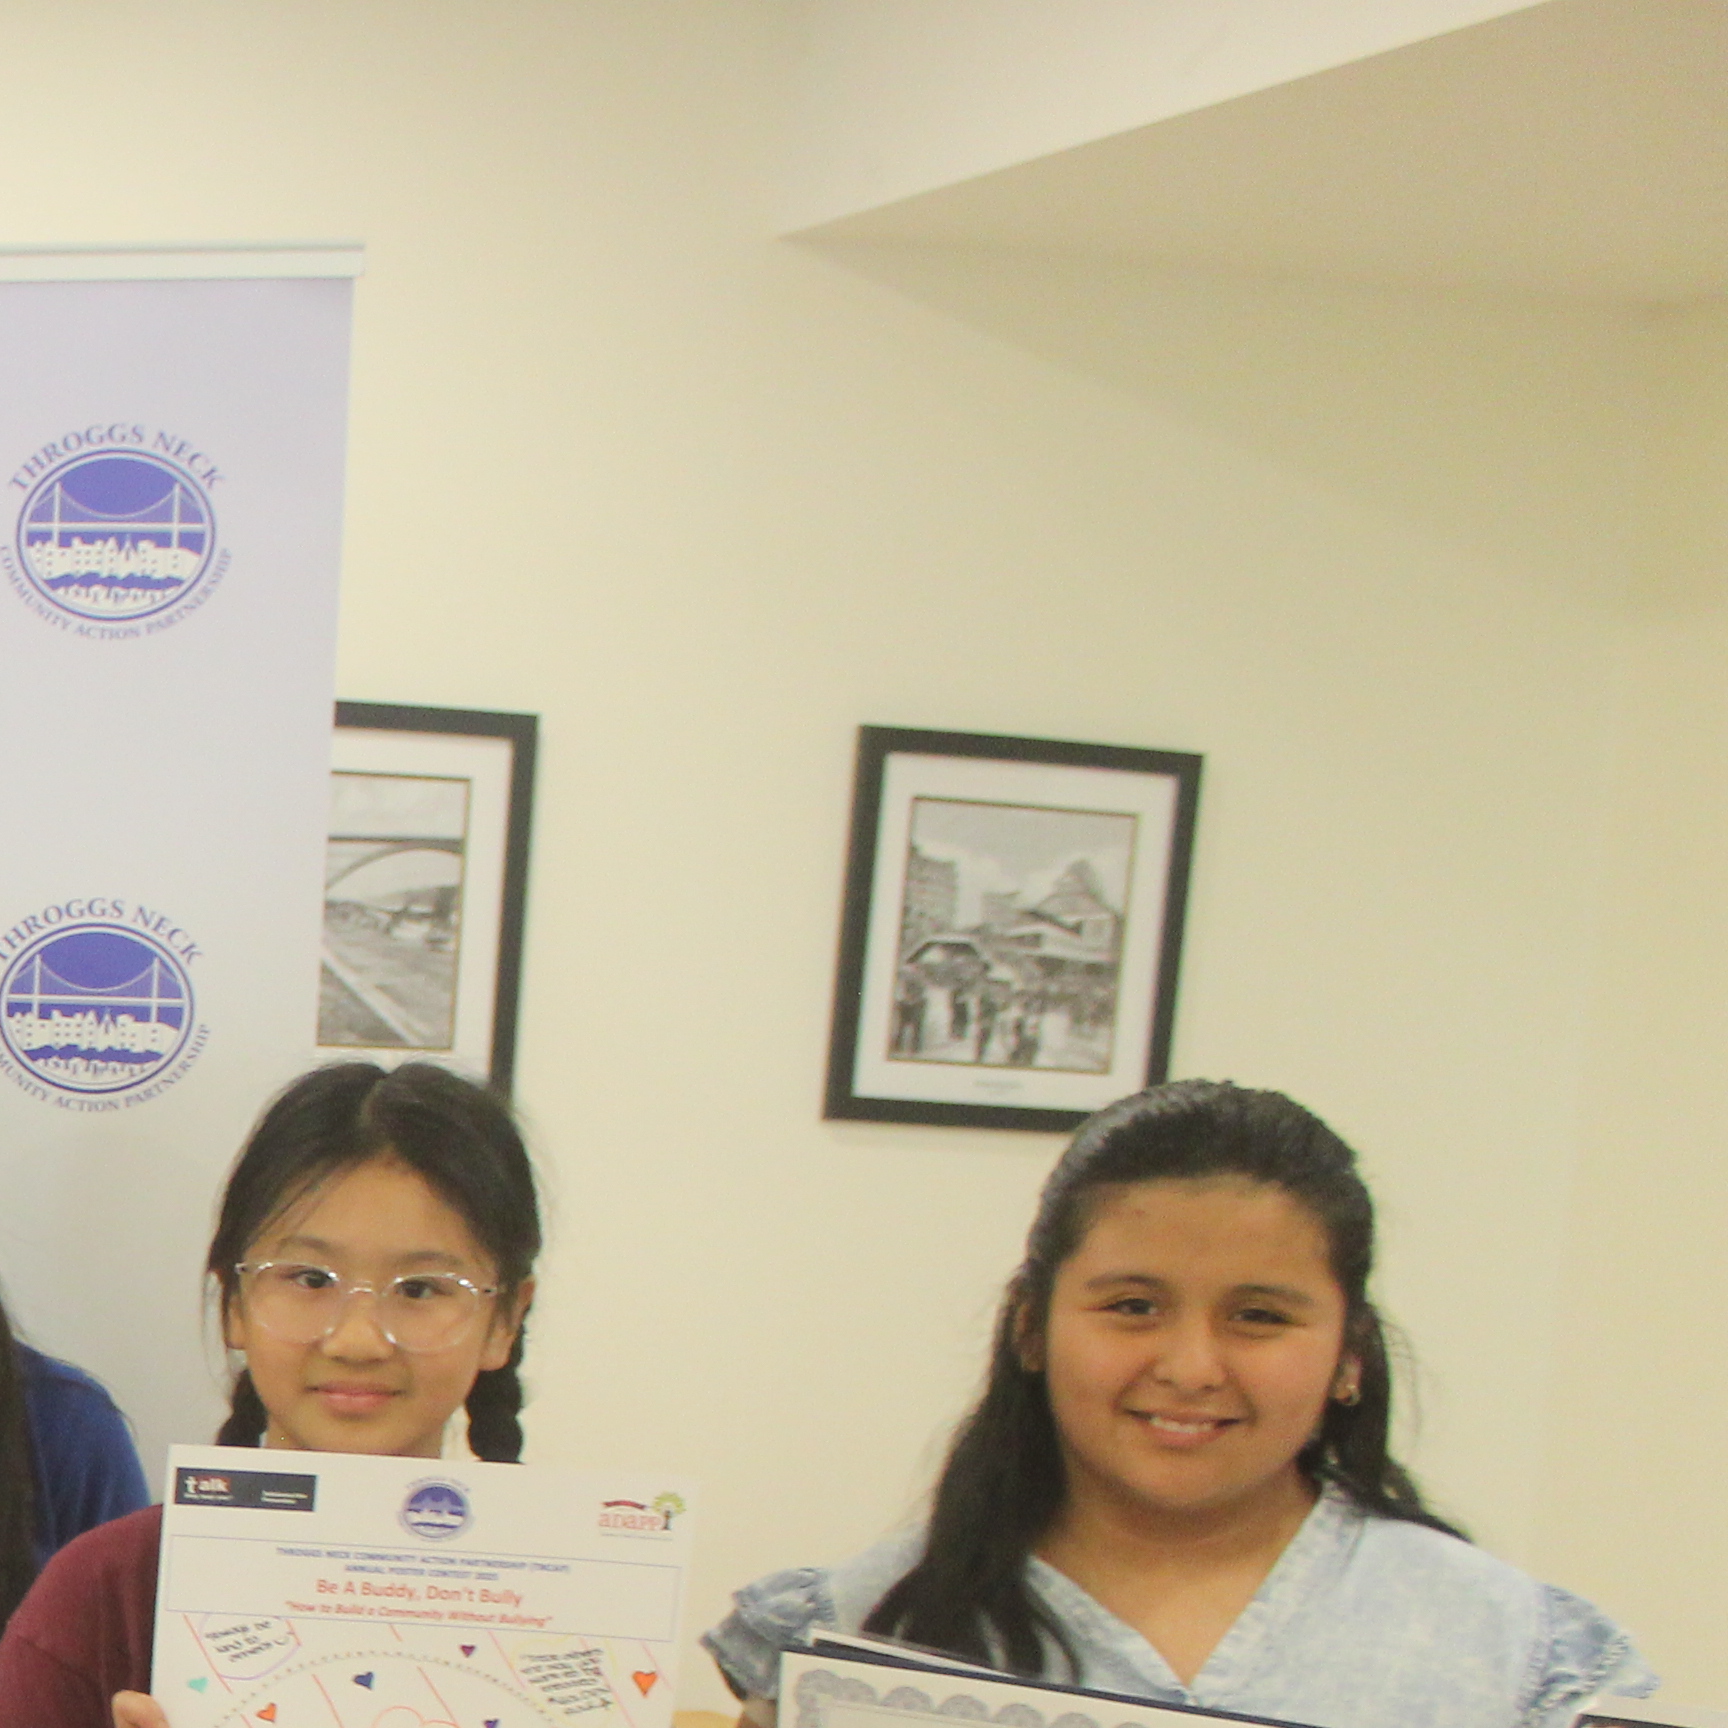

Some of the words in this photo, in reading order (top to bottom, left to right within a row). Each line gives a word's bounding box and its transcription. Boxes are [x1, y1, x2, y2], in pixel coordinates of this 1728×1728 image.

[11, 424, 145, 492] THROGGS
[153, 431, 227, 493] NECK
[0, 546, 69, 630] COMMUNITY
[75, 624, 136, 639] ACTION
[145, 547, 229, 635] PARTNERSHIP
[130, 906, 201, 968] NECK
[60, 1097, 120, 1111] ACTION
[126, 1021, 208, 1109] PARTNERSHIP
[315, 1578, 337, 1594] Be
[343, 1580, 355, 1594] A
[479, 1588, 521, 1607] Bully
